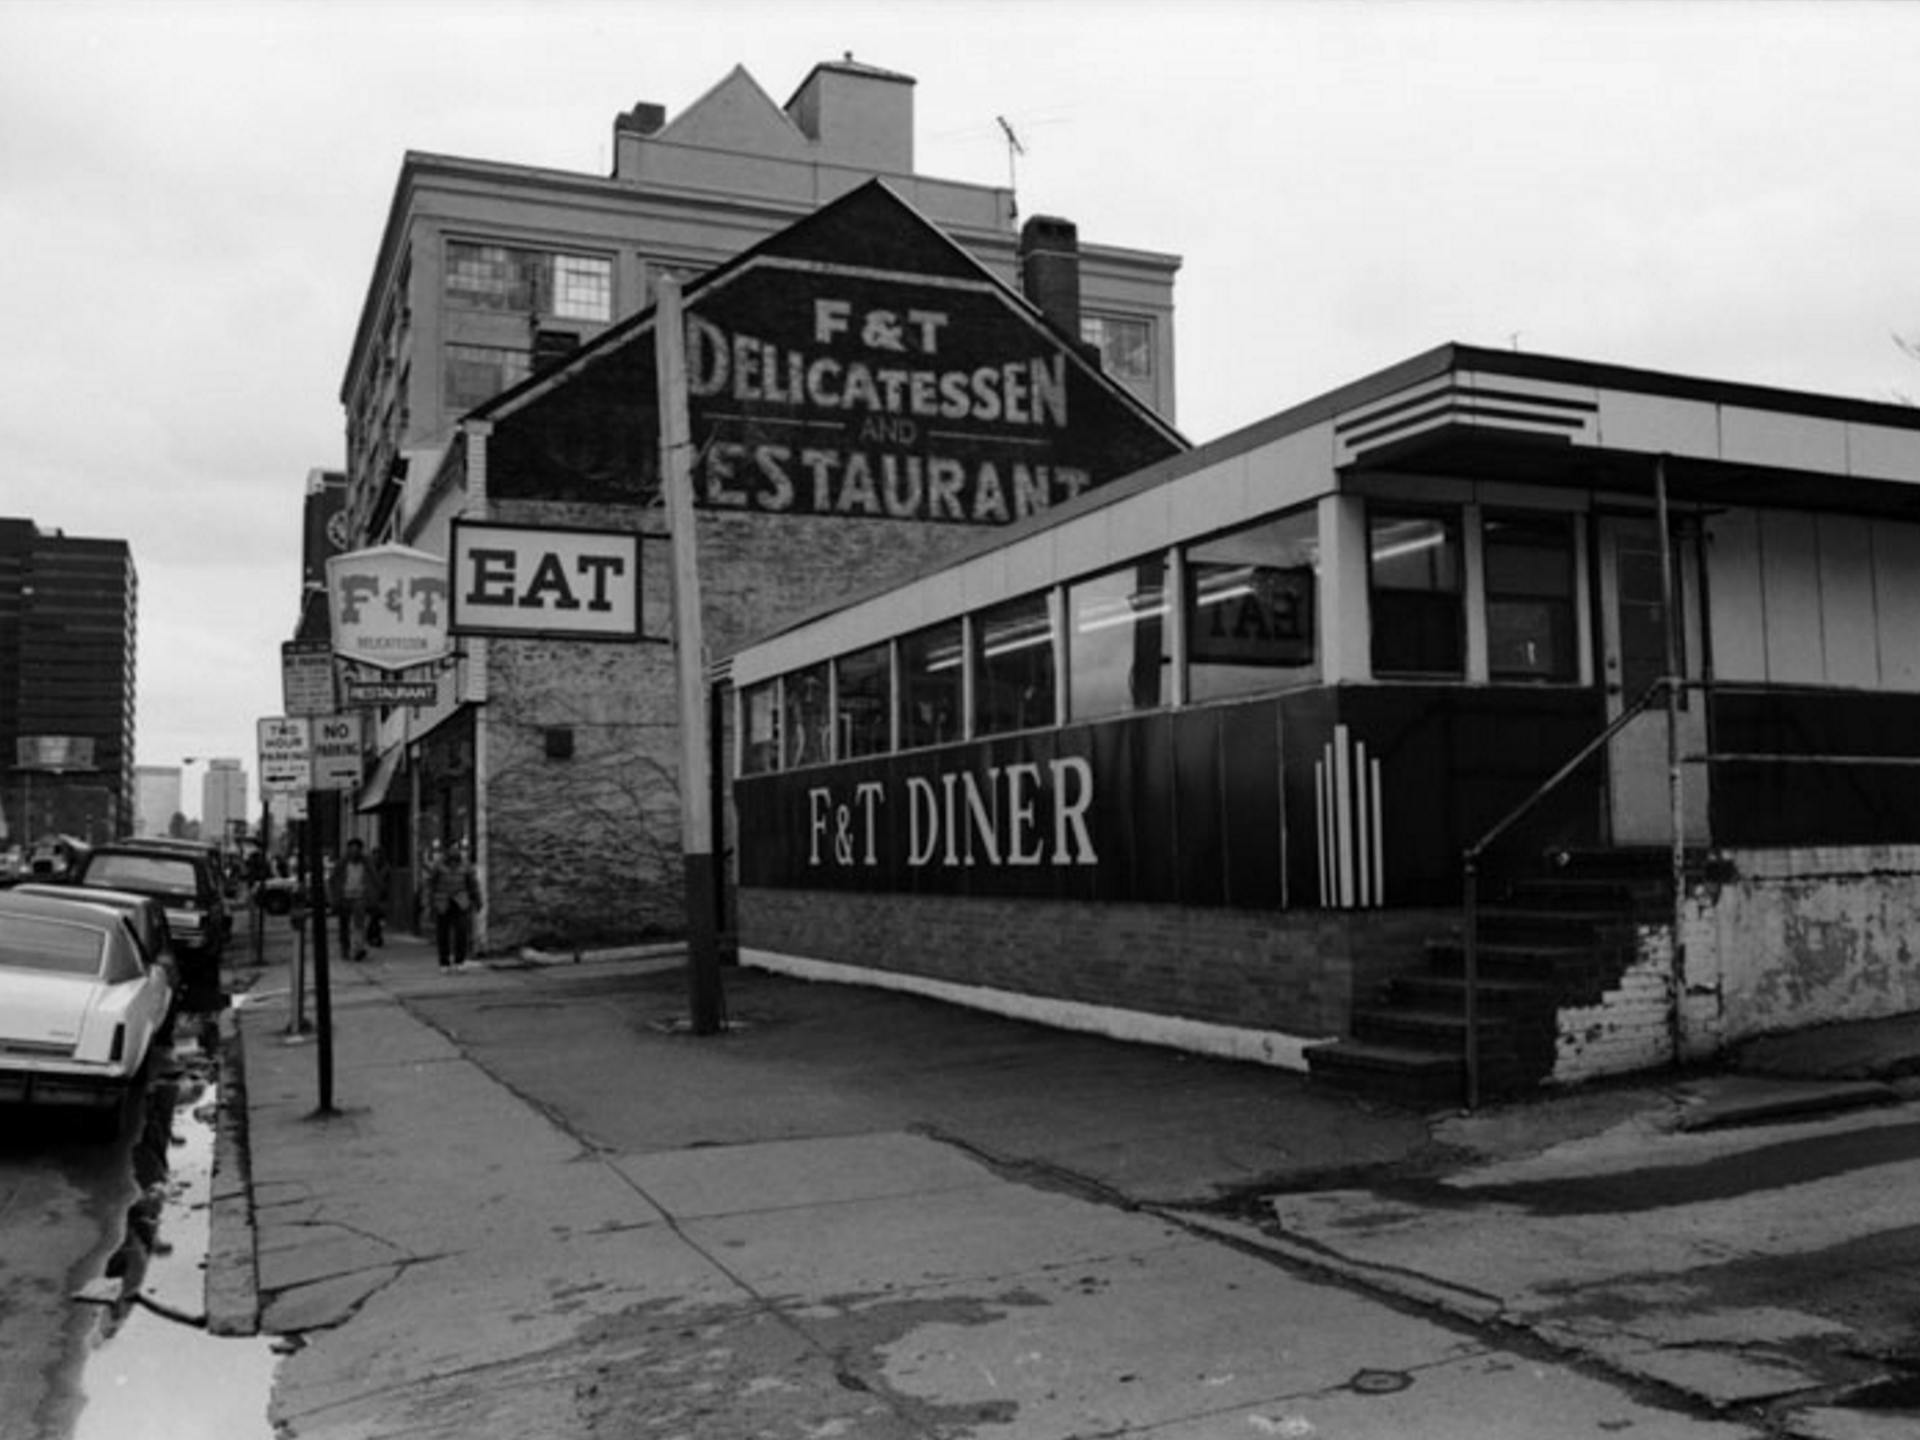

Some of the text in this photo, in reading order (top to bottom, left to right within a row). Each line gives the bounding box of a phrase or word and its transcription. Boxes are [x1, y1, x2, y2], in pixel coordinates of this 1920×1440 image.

[686, 311, 1068, 428] DELICATESSEN
[858, 417, 917, 446] AND
[691, 440, 1090, 522] ESTAURANT
[466, 548, 624, 612] EAT
[323, 723, 350, 739] NO
[906, 756, 1099, 866] DINER
